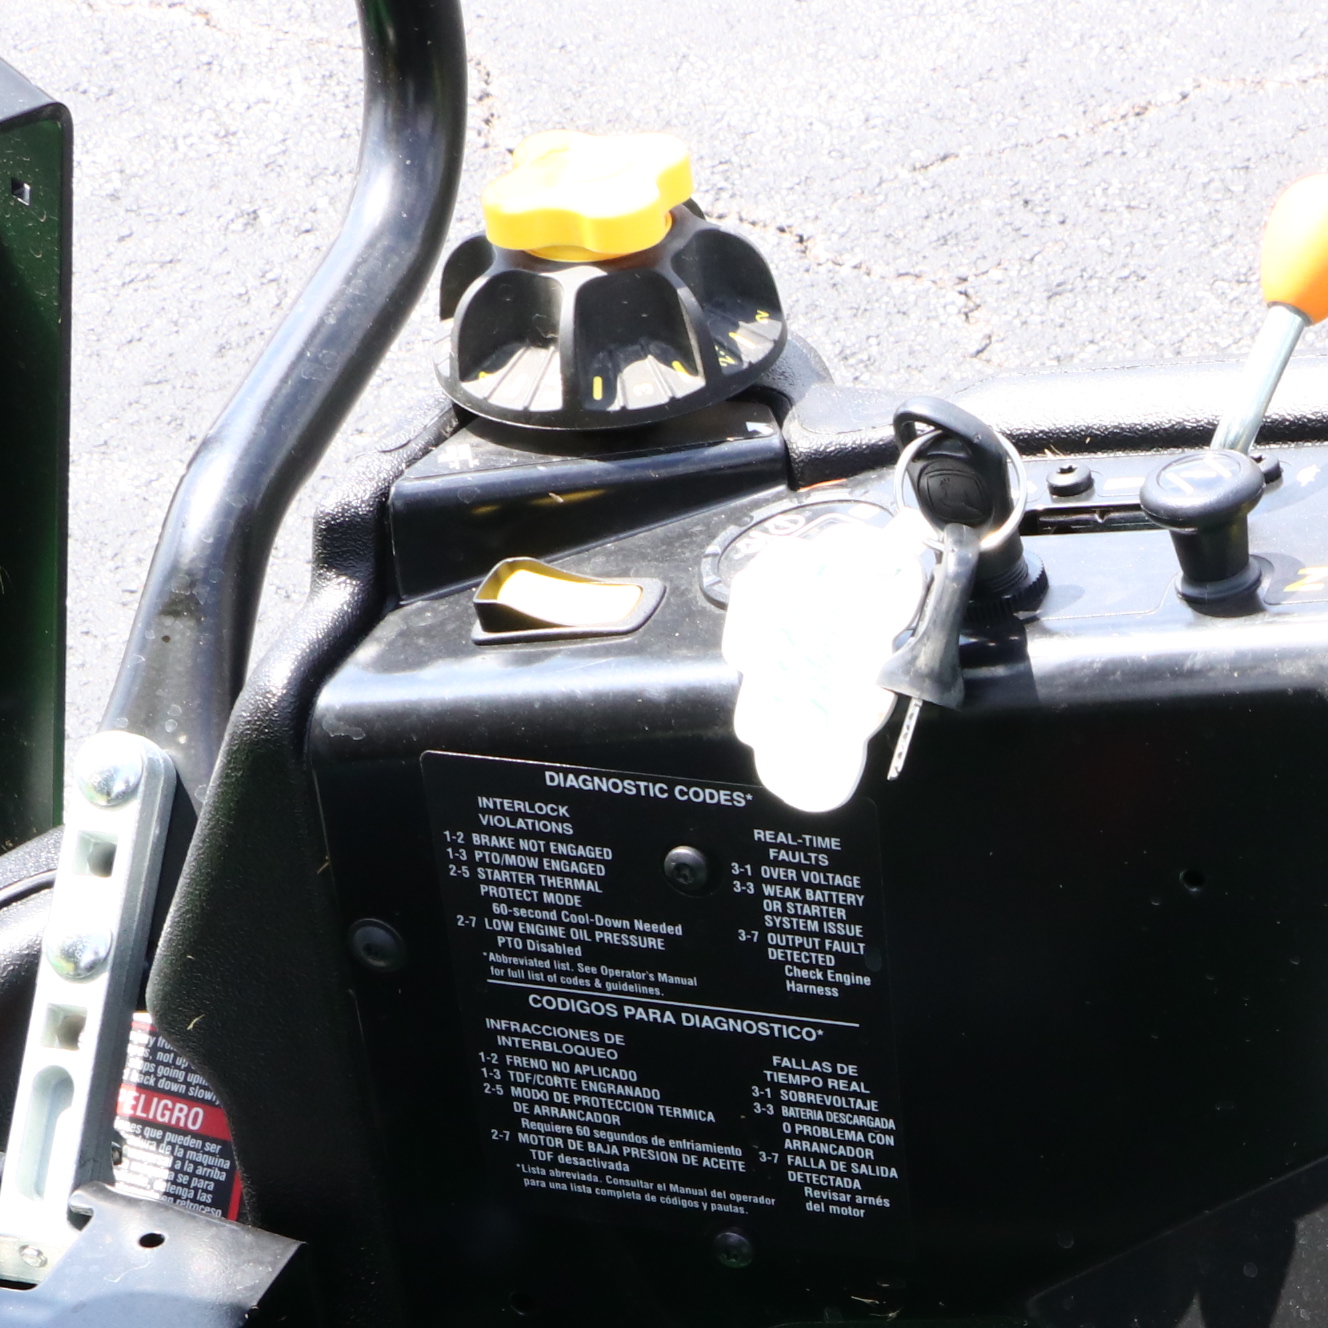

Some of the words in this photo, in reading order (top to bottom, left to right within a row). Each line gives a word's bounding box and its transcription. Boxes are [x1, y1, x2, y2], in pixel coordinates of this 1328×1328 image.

[544, 770, 668, 798] DIAGNOSTIC
[477, 796, 570, 817] INTERLOCK
[478, 813, 573, 835] VIOLATIONS
[443, 830, 464, 843] 1-2
[471, 832, 516, 849] BRAKE
[518, 838, 545, 852] NOT
[549, 841, 612, 860] ENGAGED
[753, 828, 841, 850] REAL-TIME
[446, 847, 467, 861] 1-3
[474, 850, 539, 869] PTO/MOW
[542, 857, 605, 876] ENGAGED
[769, 848, 829, 866] FAULTS
[448, 864, 470, 878] 2-5
[476, 867, 535, 885] STARTER
[538, 874, 602, 893] THERMAL
[731, 862, 751, 876] 3-1
[760, 865, 797, 881] OVER
[800, 869, 861, 888] VOLTAGE
[479, 884, 538, 902] PROTECT
[542, 891, 582, 907] MODE
[733, 880, 754, 894] 3-3
[761, 883, 802, 899] WEAK
[805, 888, 864, 906] BATTERY
[492, 902, 557, 921] 60-second
[560, 910, 630, 929] Cool-Down
[633, 918, 682, 935] Needed
[763, 899, 782, 913] OR
[786, 901, 846, 920] STARTER
[456, 914, 476, 927] 2-7
[484, 917, 514, 932] LOW
[517, 921, 566, 938] ENGINE
[569, 927, 592, 941] OIL
[594, 930, 665, 950] PRESSURE
[764, 914, 819, 932] SYSTEM
[823, 921, 863, 937] ISSUE
[497, 935, 523, 950] PTO
[526, 939, 582, 956] Disabled
[738, 929, 759, 942] 3-7
[767, 932, 820, 950] OUTPUT
[824, 938, 865, 955] FAULT
[767, 947, 835, 966] DETECTED
[490, 965, 504, 976] for
[507, 967, 525, 979] full
[527, 970, 545, 982] list
[546, 973, 557, 983] of
[559, 975, 591, 987] codes
[593, 977, 602, 988] &
[605, 981, 664, 996] guidelines.
[553, 959, 574, 971] list.
[576, 962, 597, 974] See
[600, 965, 655, 981] Operator's
[657, 972, 697, 986] Manual
[784, 964, 823, 980] Check
[827, 969, 871, 986] Engine
[785, 979, 839, 997] Harness
[528, 993, 618, 1017] CODIGOS
[623, 1005, 676, 1024] PARA
[485, 1017, 600, 1042] INFRACCIONES
[603, 1032, 625, 1045] DE
[156, 1051, 174, 1064] not
[496, 1035, 618, 1060] INTERBLOQUEO
[157, 1064, 185, 1082] going
[158, 1077, 187, 1094] down
[144, 1126, 163, 1139] que
[165, 1132, 202, 1149] pueden
[204, 1142, 222, 1154] ser
[174, 1146, 184, 1157] la
[186, 1150, 230, 1169] máquina
[177, 1173, 189, 1184] se
[190, 1177, 215, 1191] para
[184, 1160, 193, 1172] la
[196, 1165, 227, 1181] arriba
